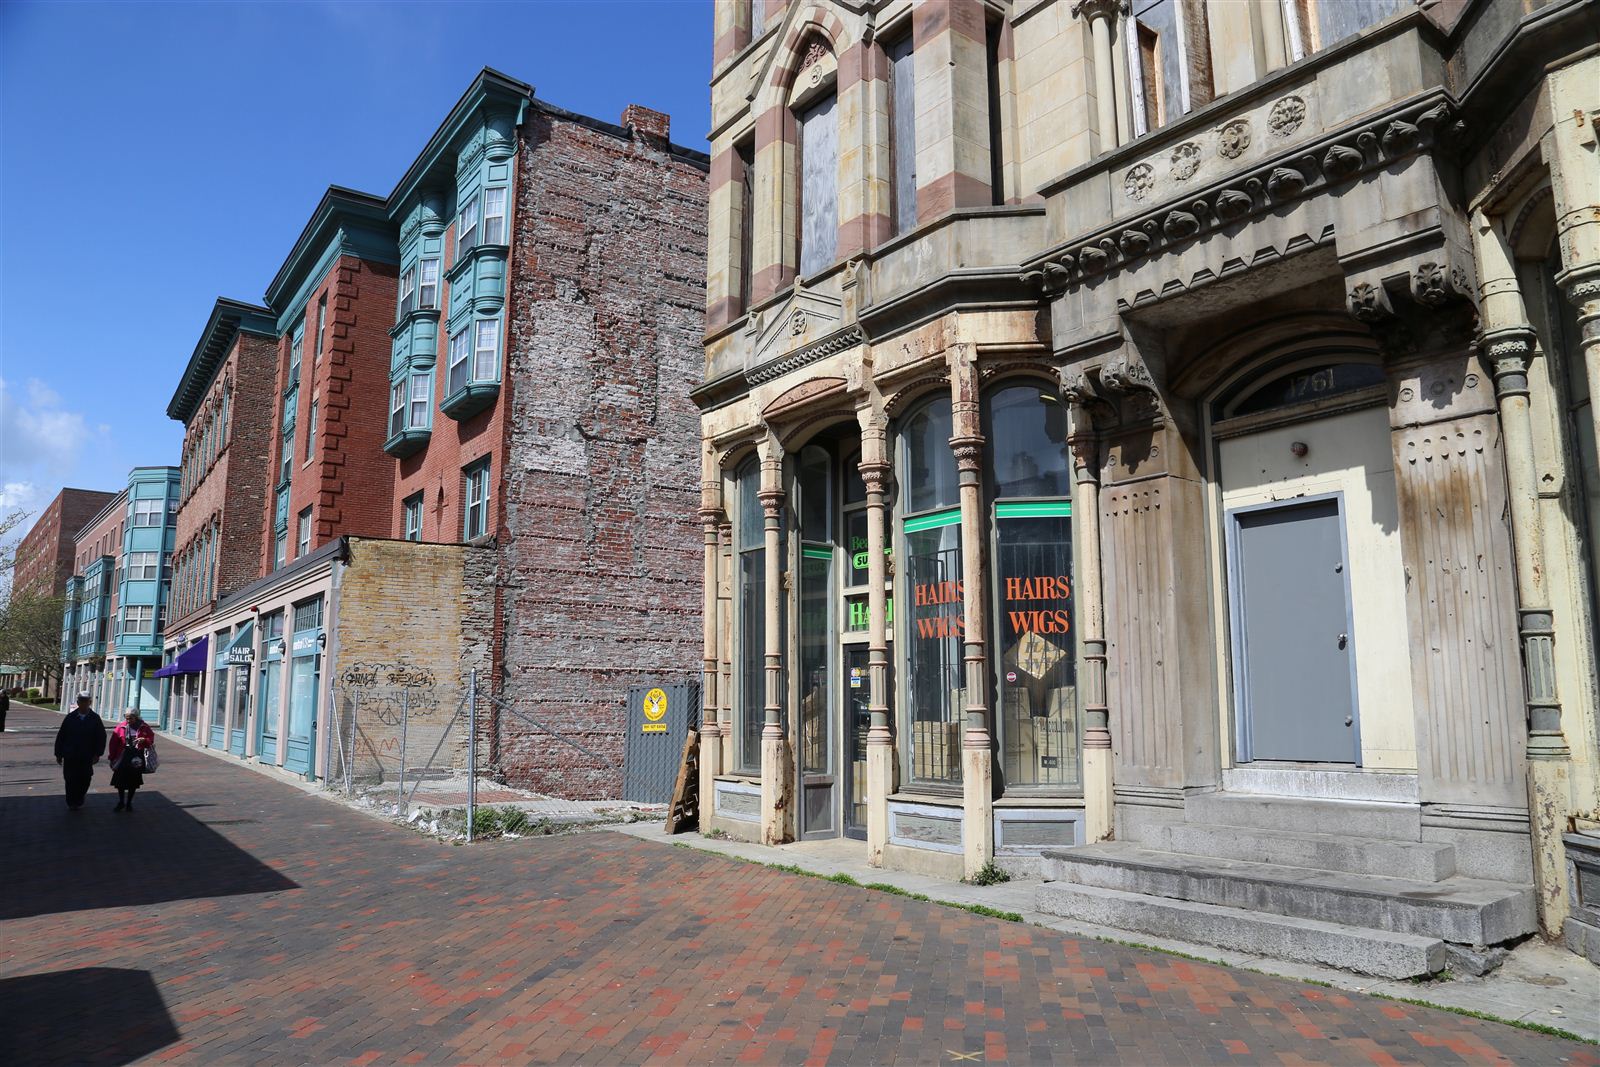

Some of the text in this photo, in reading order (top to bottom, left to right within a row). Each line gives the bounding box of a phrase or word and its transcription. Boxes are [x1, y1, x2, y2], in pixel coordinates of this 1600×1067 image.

[1289, 368, 1335, 397] 1761
[915, 579, 964, 607] HAIRS
[1006, 575, 1070, 601] HAIRS
[917, 614, 965, 640] WIGS
[1008, 609, 1069, 634] WIGS
[229, 654, 251, 663] SALO
[231, 647, 250, 655] HAIR
